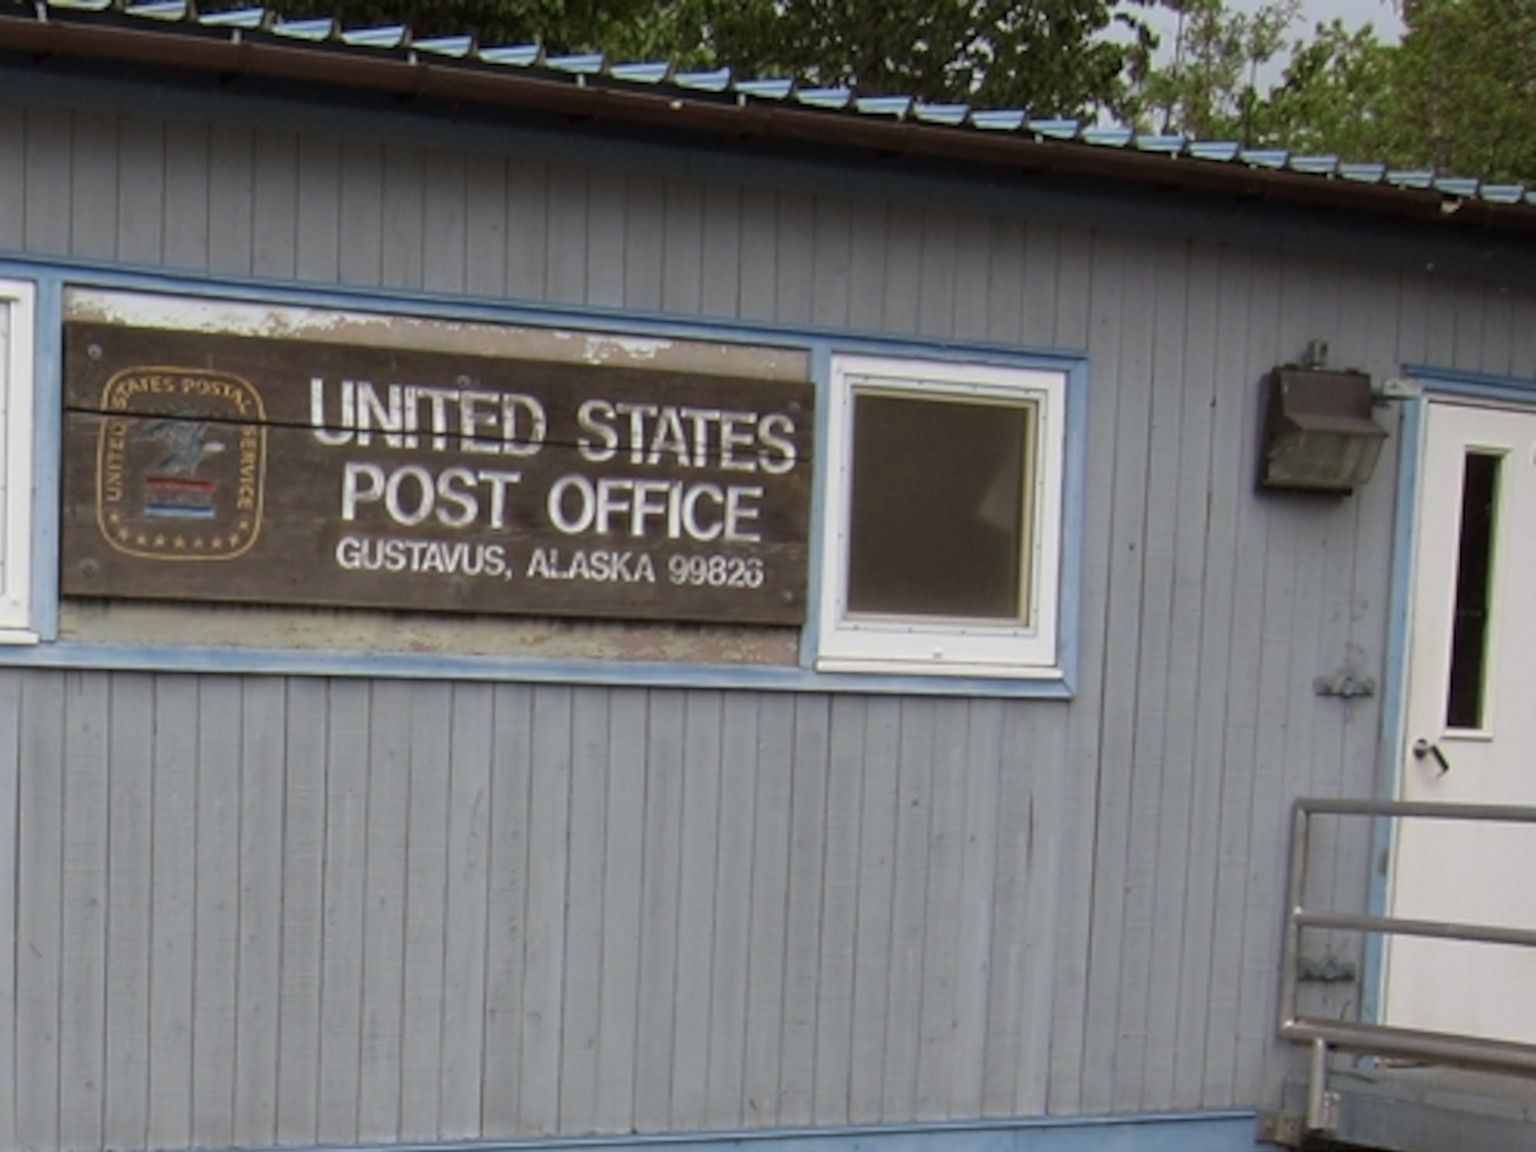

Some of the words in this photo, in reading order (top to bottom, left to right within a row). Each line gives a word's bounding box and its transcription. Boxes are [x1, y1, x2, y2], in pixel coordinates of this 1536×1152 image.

[115, 377, 175, 409] STATES
[182, 378, 252, 415] POSTAL
[311, 377, 547, 457] UNITED
[577, 399, 797, 474] STATES
[107, 422, 128, 501] UNITED
[236, 424, 257, 510] SERVICE
[341, 461, 522, 529] POST
[547, 473, 764, 543] OFFICE
[335, 535, 513, 581] GUSTAVUS,
[526, 548, 656, 582] ALASKA
[668, 555, 764, 589] 99826
